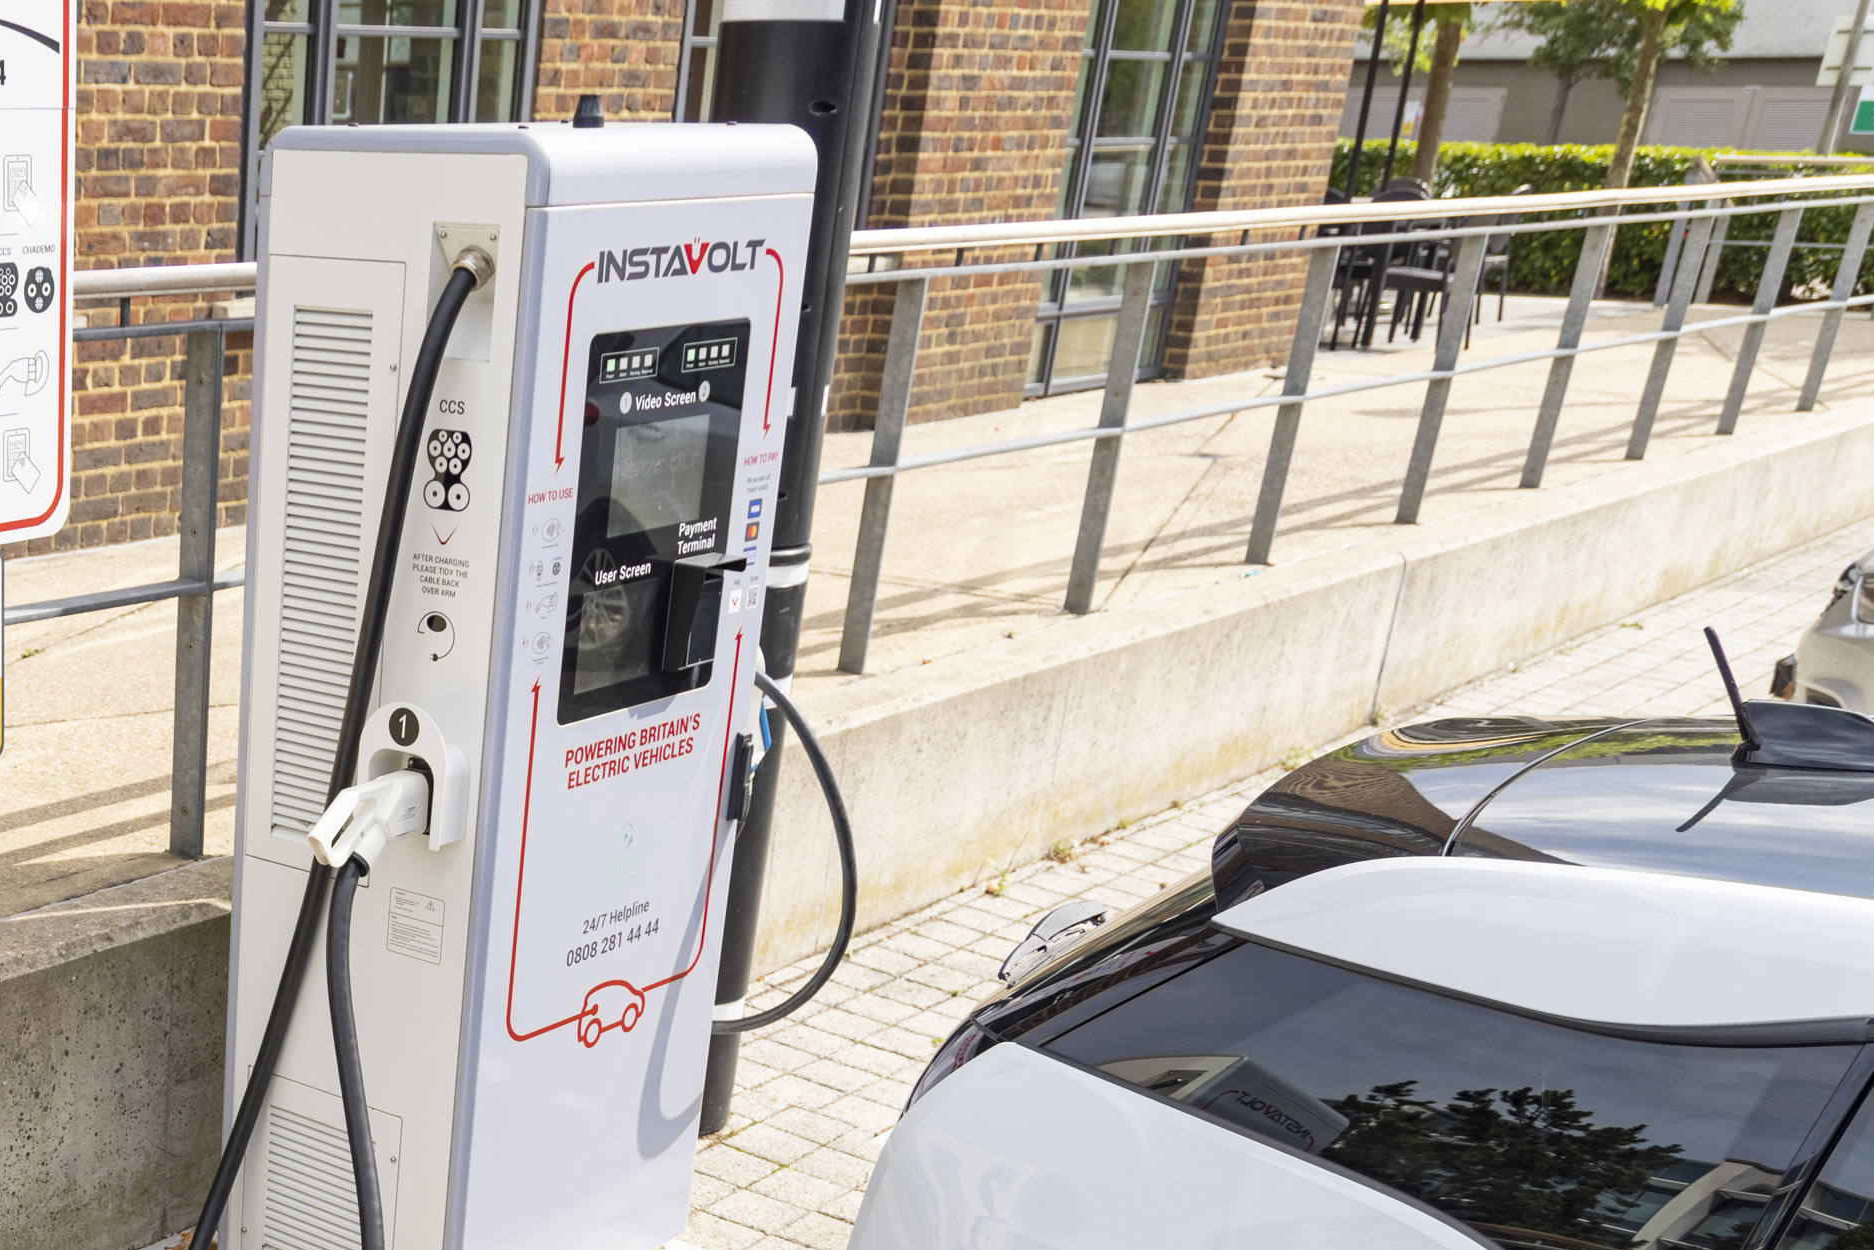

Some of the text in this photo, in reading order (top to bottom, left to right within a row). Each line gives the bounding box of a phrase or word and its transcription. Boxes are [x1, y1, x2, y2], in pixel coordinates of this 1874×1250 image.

[22, 244, 55, 254] CHADEMO
[597, 238, 765, 283] INSTAVOLT
[440, 399, 465, 414] CCS
[636, 391, 696, 410] Video Screen
[744, 451, 779, 466] HOW TO PAY
[528, 488, 573, 504] HOW TO USE
[678, 517, 717, 537] Payment
[677, 534, 715, 555] Terminal
[413, 553, 469, 568] AFTER CHARGING
[413, 564, 468, 579] PLEASE TIDY THE
[595, 562, 651, 586] User Screen
[420, 575, 459, 588] CABLE BACK
[422, 587, 455, 598] OVER ARM
[399, 714, 407, 739] 1
[565, 713, 700, 768] POWERING BRITAIN'S
[568, 737, 693, 790] ELECTRIC VEHICLES
[583, 900, 649, 935] 24/7 Helpline
[566, 919, 659, 967] 0808 281 44 44
